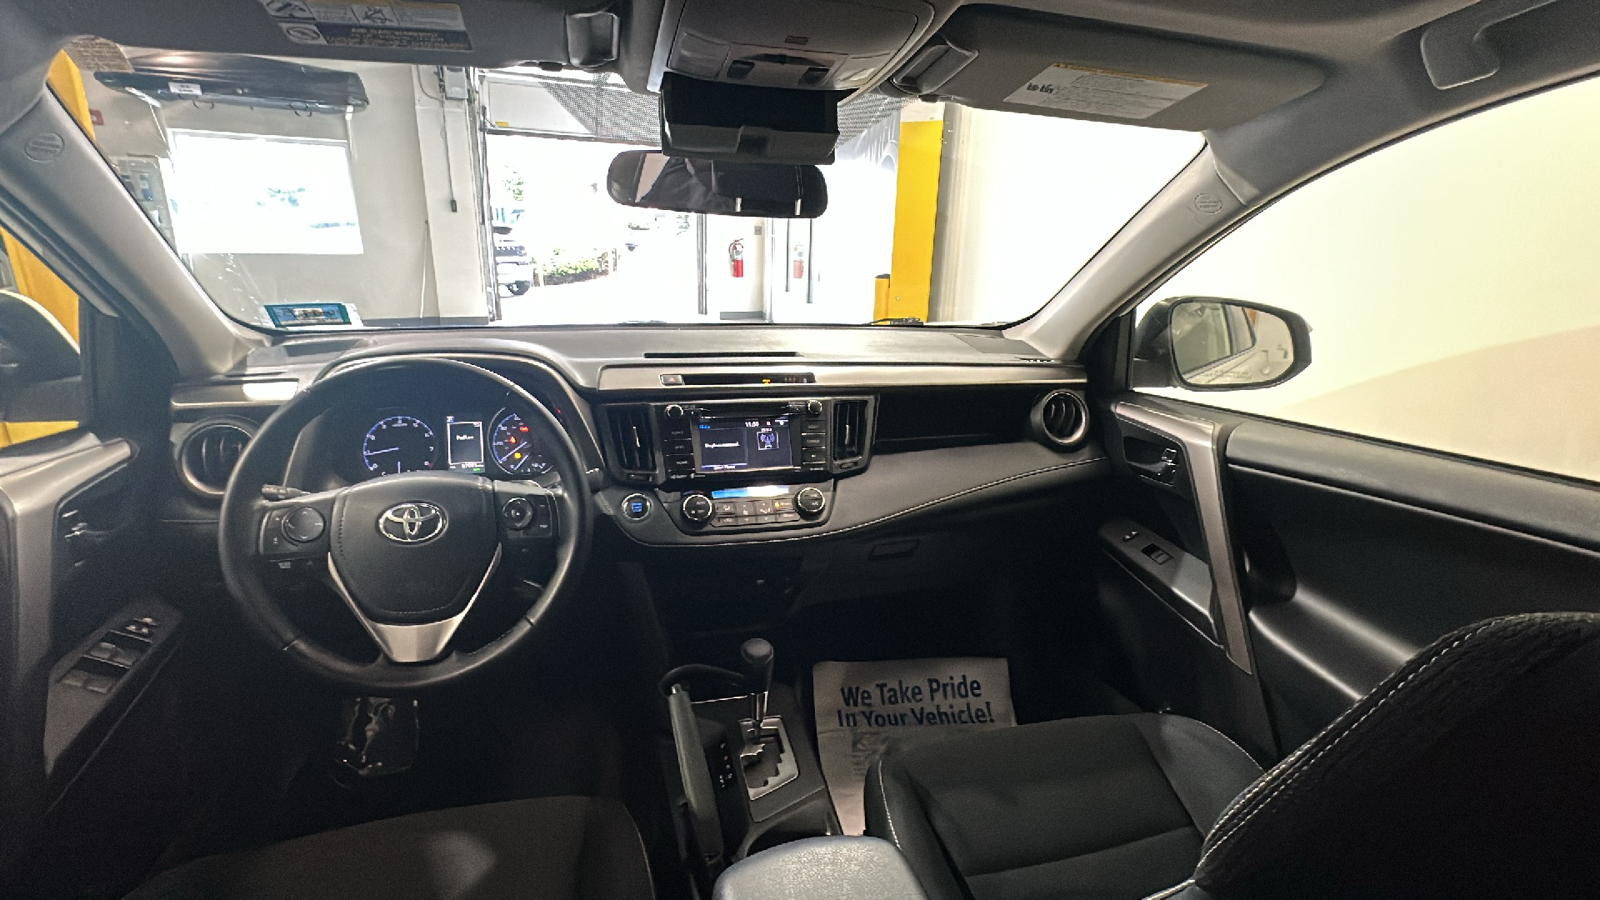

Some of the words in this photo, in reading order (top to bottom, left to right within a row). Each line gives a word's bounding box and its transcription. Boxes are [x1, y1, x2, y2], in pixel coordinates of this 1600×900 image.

[840, 686, 872, 707] We
[875, 679, 923, 706] Take
[927, 674, 982, 702] Pride
[837, 709, 858, 727] In
[861, 708, 907, 727] Your
[910, 701, 995, 726] Vehicle!
